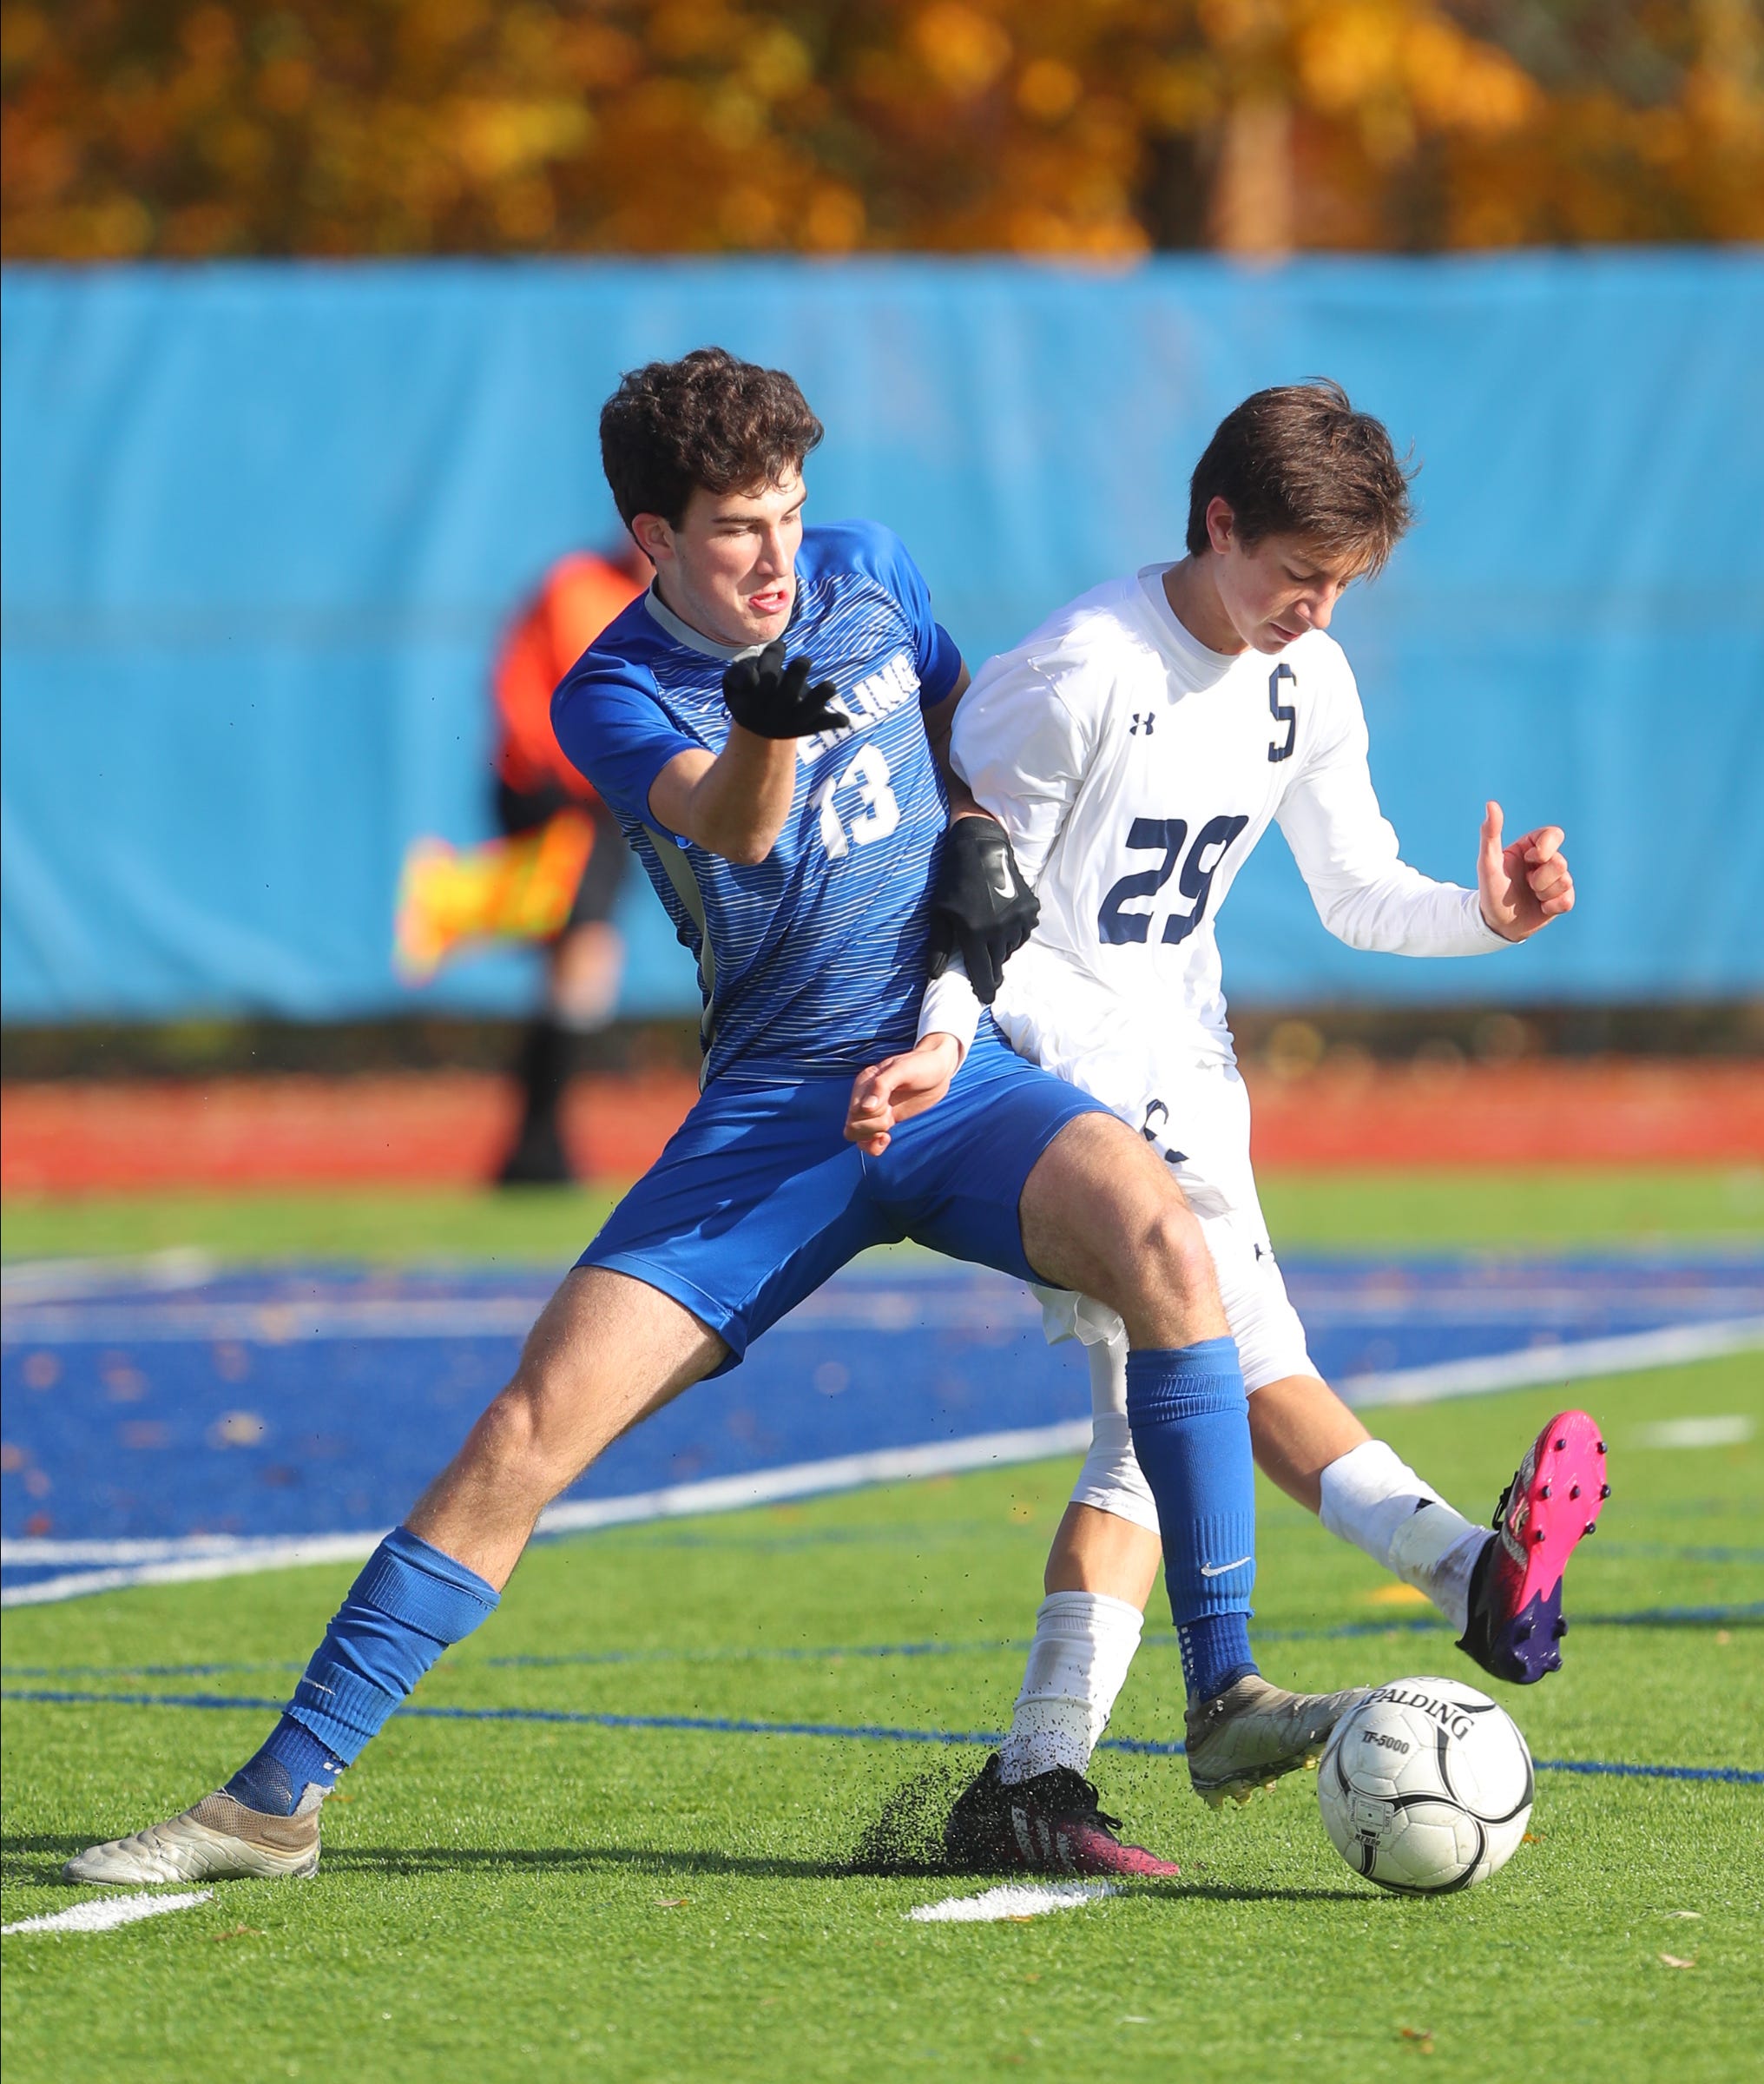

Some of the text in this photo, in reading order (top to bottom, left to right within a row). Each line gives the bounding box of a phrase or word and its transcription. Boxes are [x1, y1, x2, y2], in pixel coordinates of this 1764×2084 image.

[1268, 663, 1297, 762] S
[808, 743, 900, 861] 13
[1098, 815, 1250, 946] 29
[1362, 1731, 1410, 1754] TF-5000
